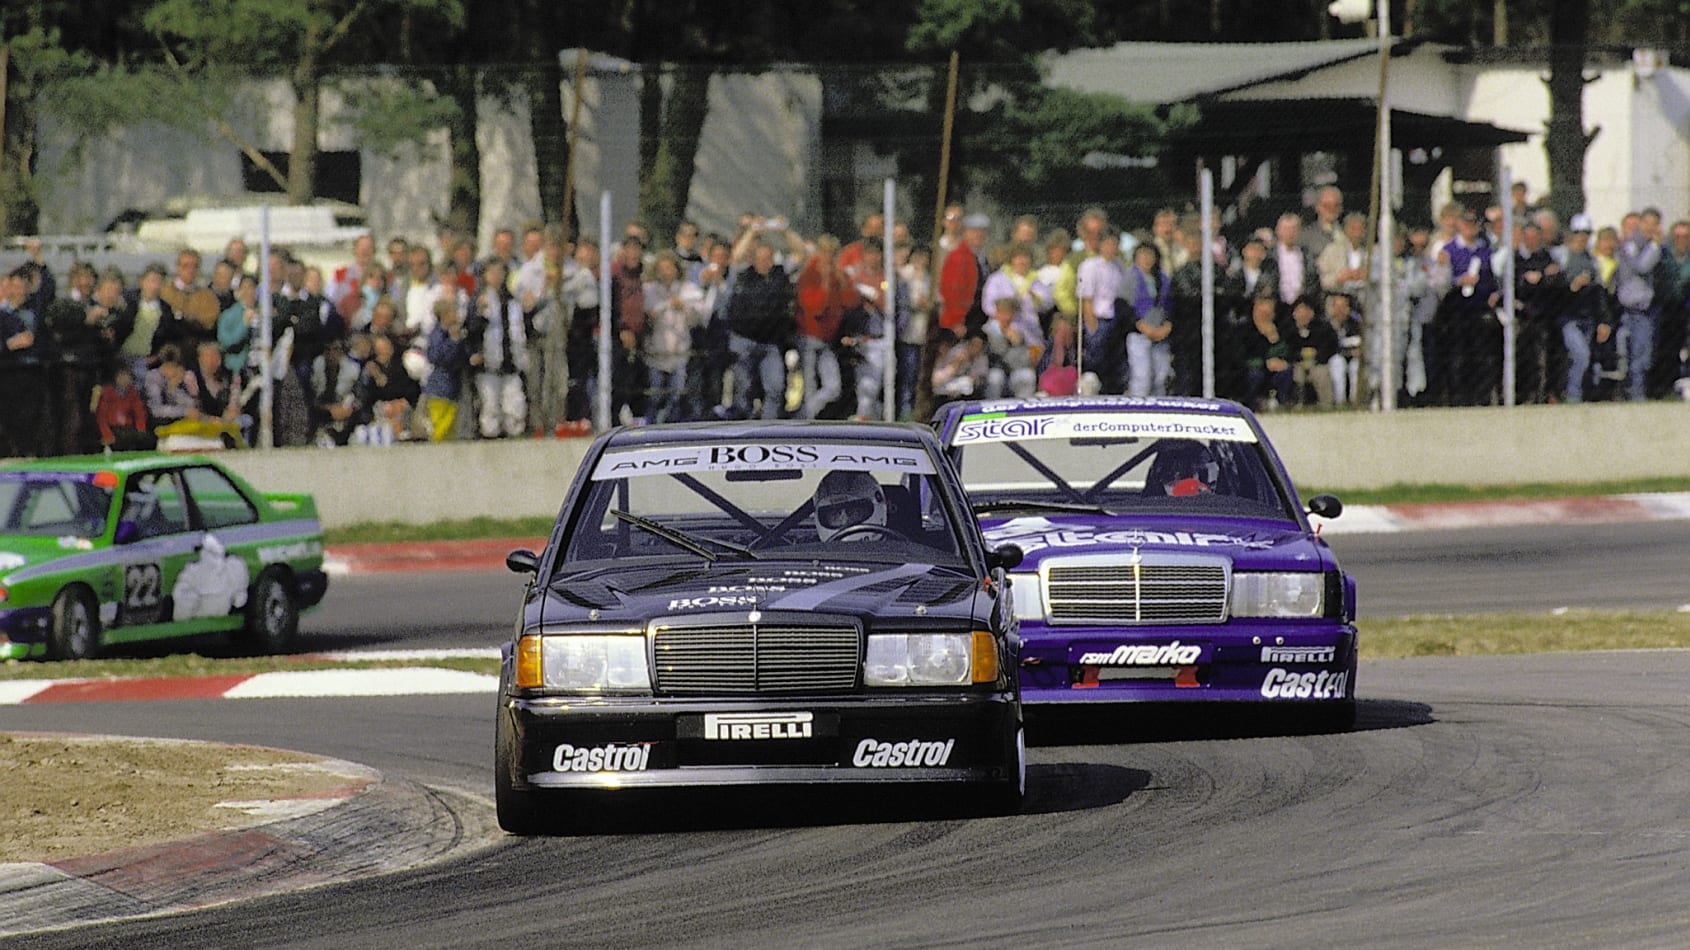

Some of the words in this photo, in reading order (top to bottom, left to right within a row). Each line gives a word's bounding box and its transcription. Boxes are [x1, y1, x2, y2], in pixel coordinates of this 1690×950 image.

[958, 417, 1054, 441] star
[611, 457, 698, 471] AMG
[711, 445, 819, 464] BOSS
[830, 455, 918, 466] AMG
[1109, 641, 1202, 665] marko
[1261, 646, 1336, 663] PIRELLI
[1261, 667, 1350, 698] Castrol
[704, 711, 814, 740] PIRELLI
[553, 743, 651, 772] Castrol
[852, 738, 955, 767] Castrol
